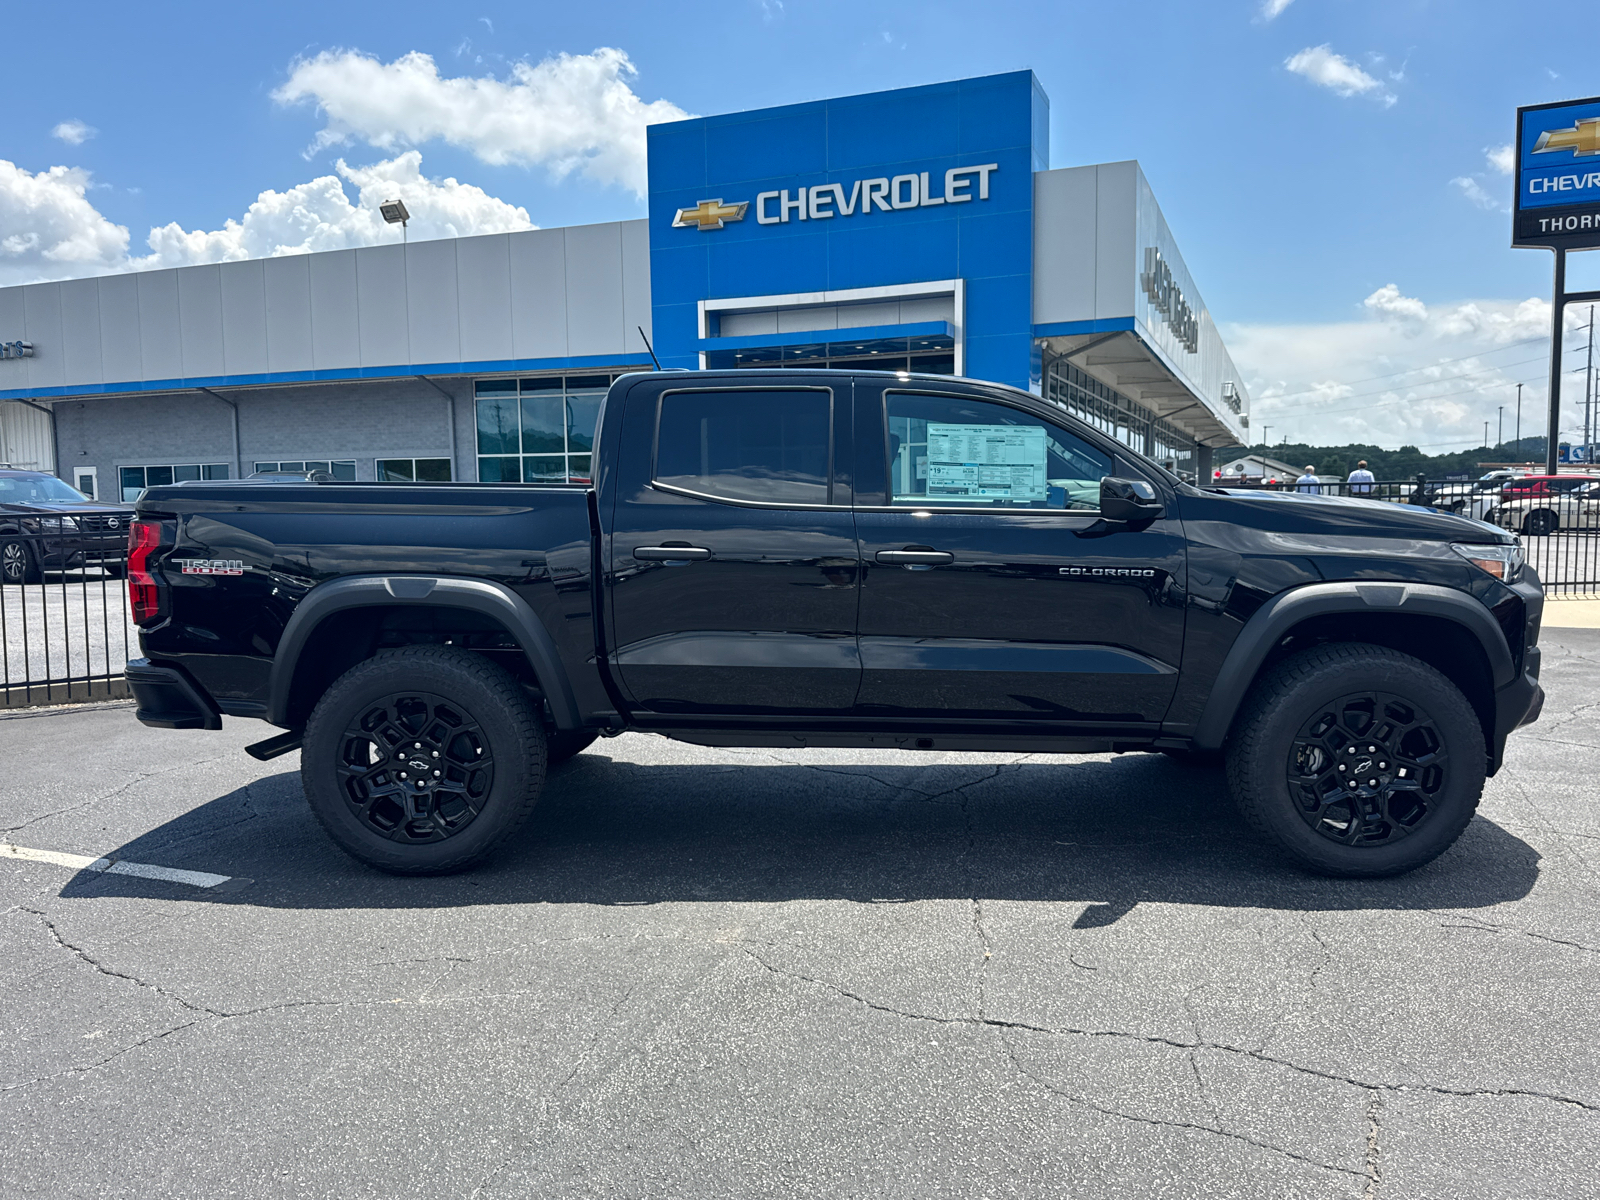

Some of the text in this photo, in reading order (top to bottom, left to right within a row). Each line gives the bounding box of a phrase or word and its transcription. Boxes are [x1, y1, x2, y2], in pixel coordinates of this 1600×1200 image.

[1529, 172, 1600, 194] CHEVR
[756, 163, 998, 225] CHEVROLET
[171, 558, 253, 569] TRAIL
[182, 567, 243, 575] BOSS
[1058, 567, 1155, 577] COLORADO
